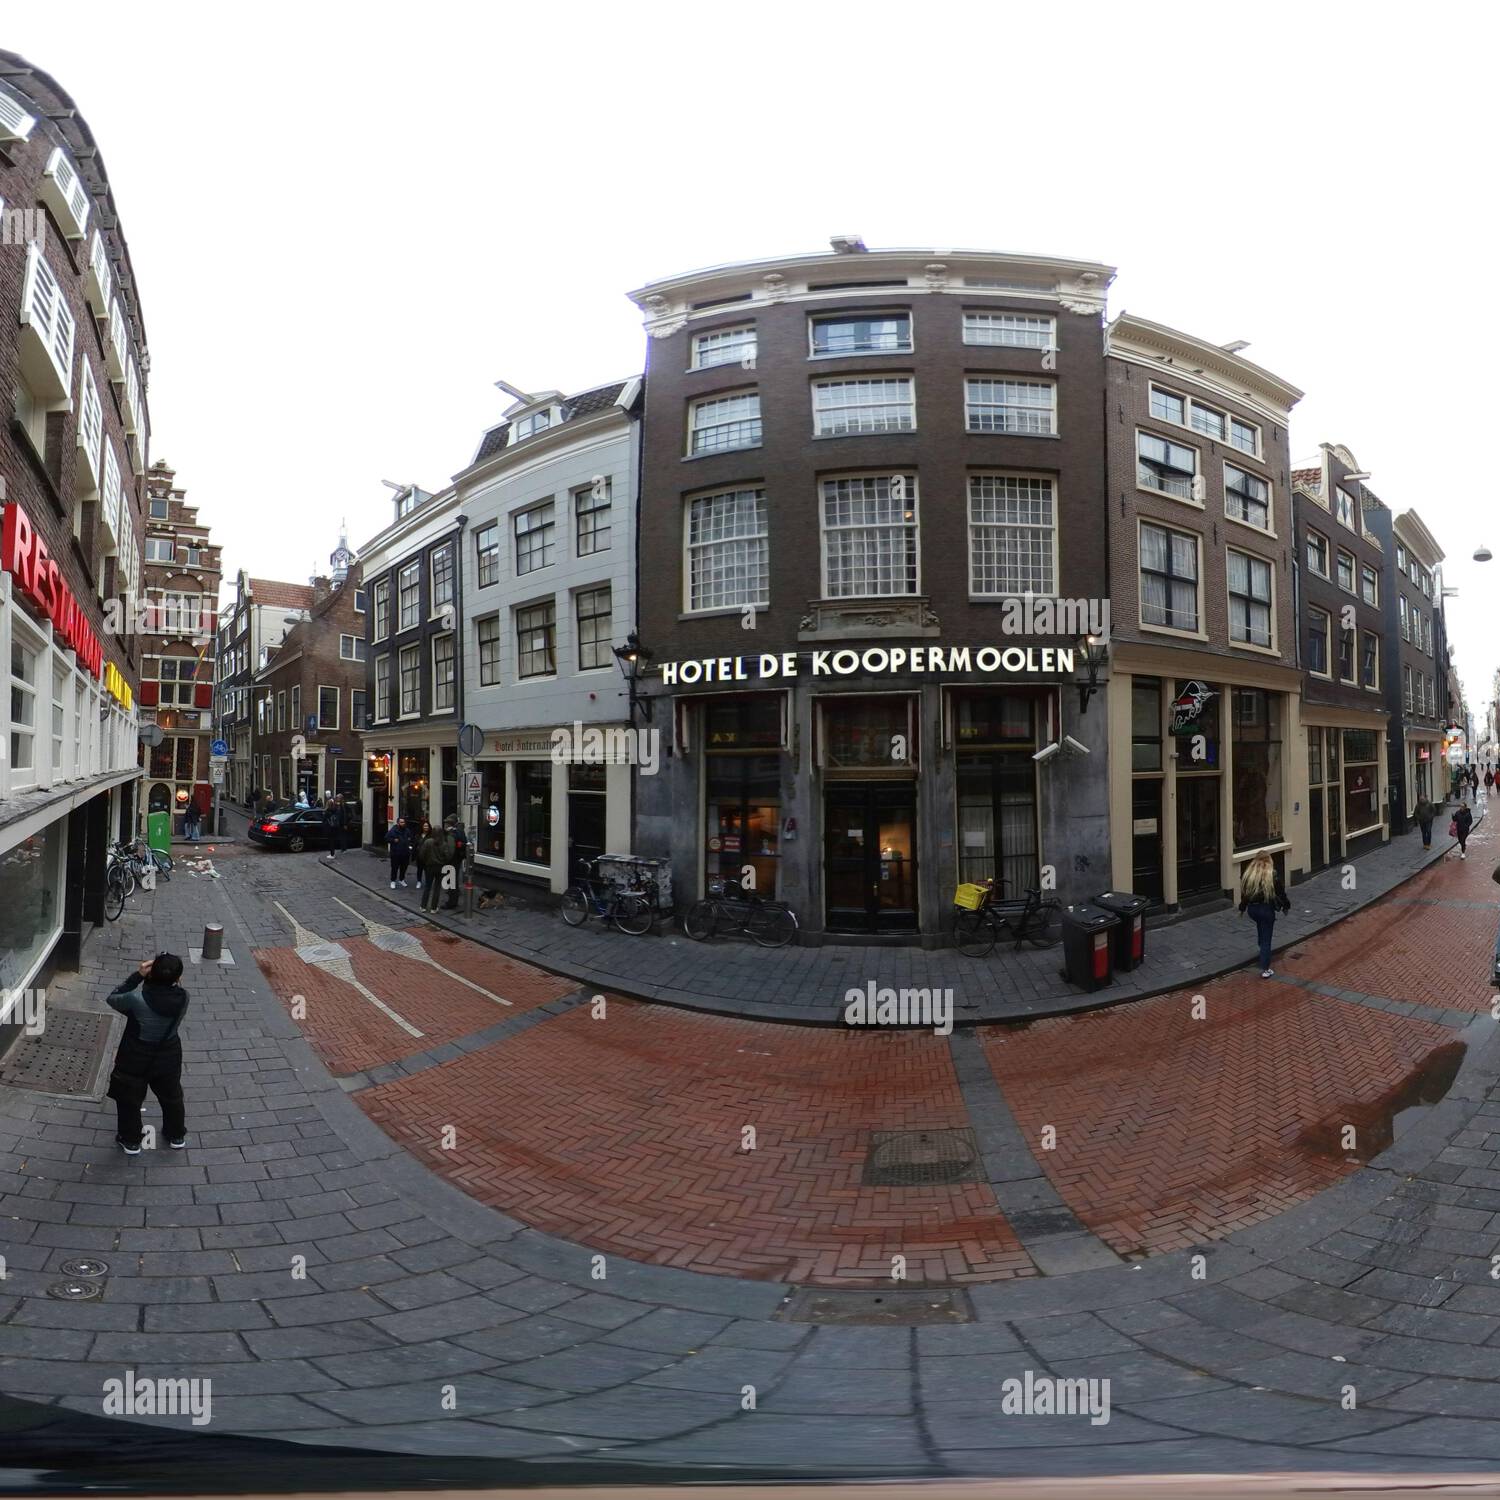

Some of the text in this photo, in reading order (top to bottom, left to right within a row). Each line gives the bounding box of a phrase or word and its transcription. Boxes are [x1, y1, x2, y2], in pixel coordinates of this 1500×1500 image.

[2, 503, 103, 682] RESTAURANT
[662, 646, 1075, 685] HOTEL DE KOOPERMOOLEN
